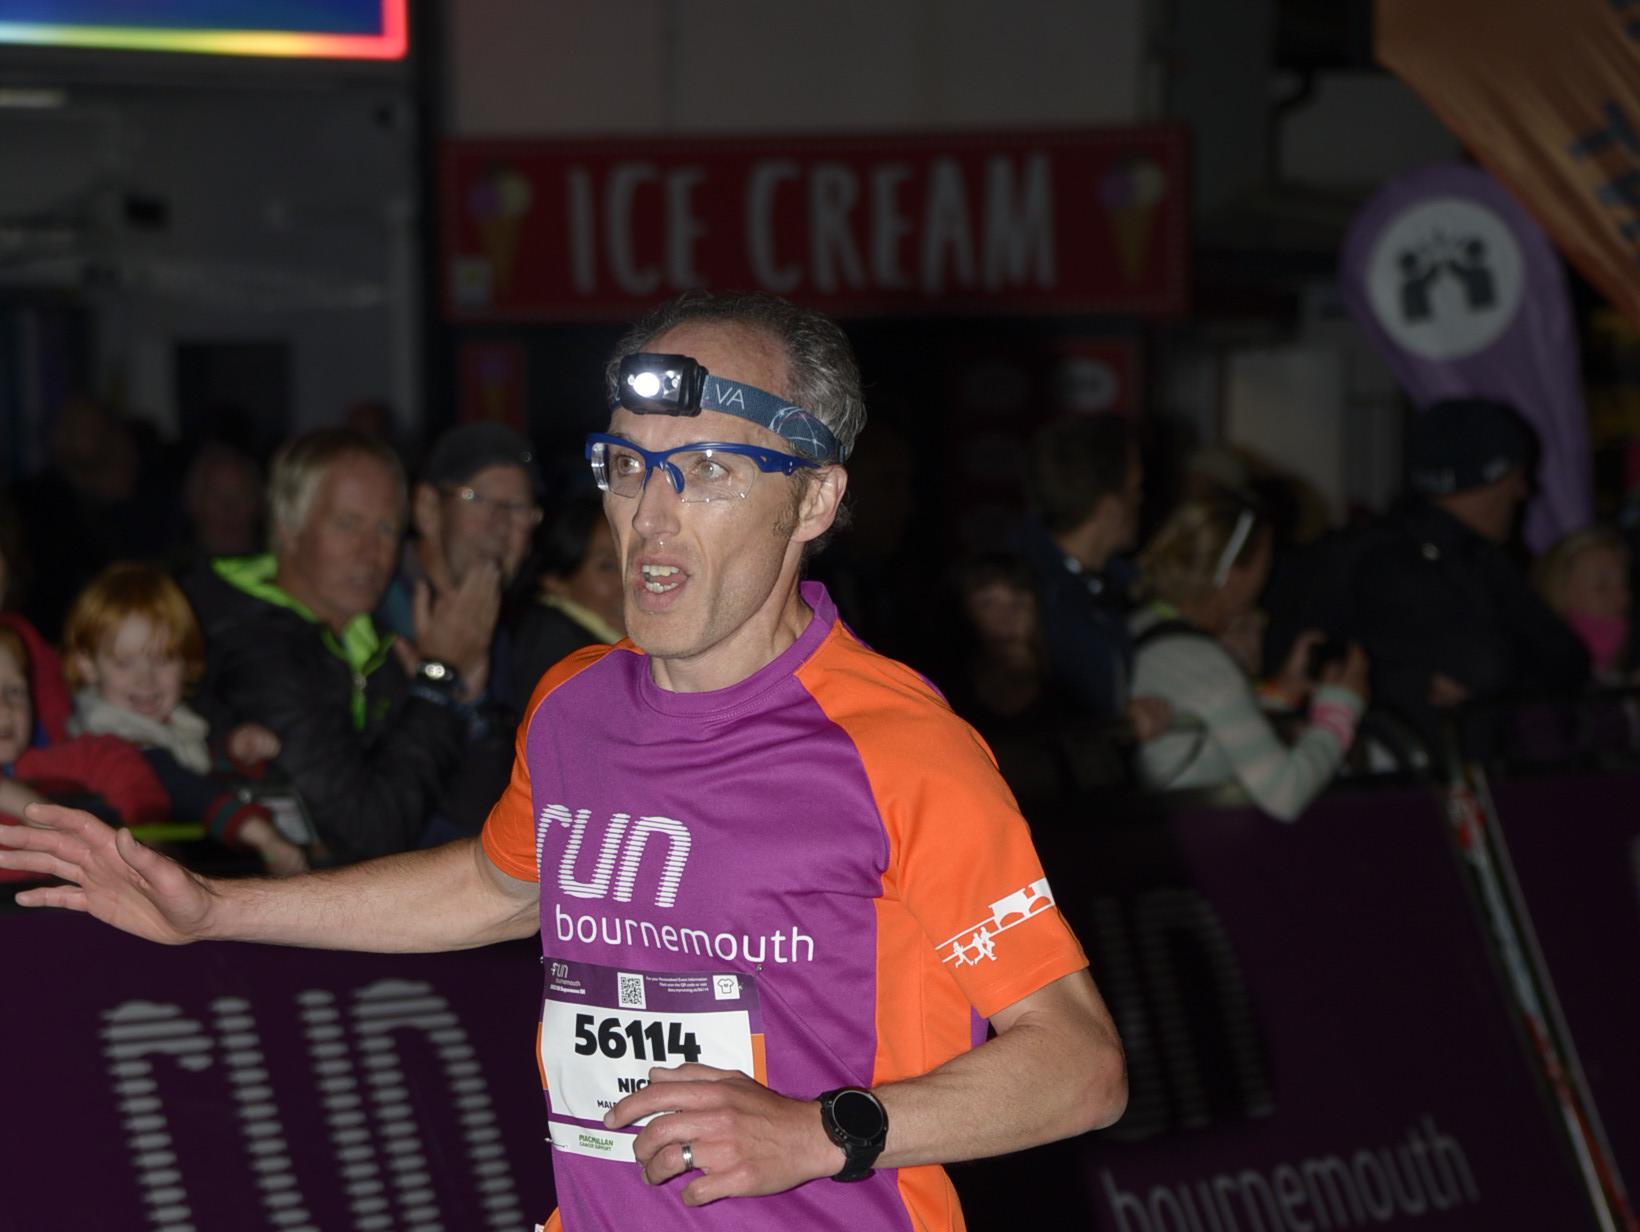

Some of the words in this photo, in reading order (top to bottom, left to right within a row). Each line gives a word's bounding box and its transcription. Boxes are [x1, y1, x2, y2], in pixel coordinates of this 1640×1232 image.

[566, 158, 708, 296] ICE
[742, 149, 1060, 297] CREAM
[704, 383, 745, 410] VA
[537, 803, 692, 908] run
[555, 903, 815, 964] bournemouth
[574, 1013, 702, 1063] 56114
[617, 1077, 651, 1094] NIC
